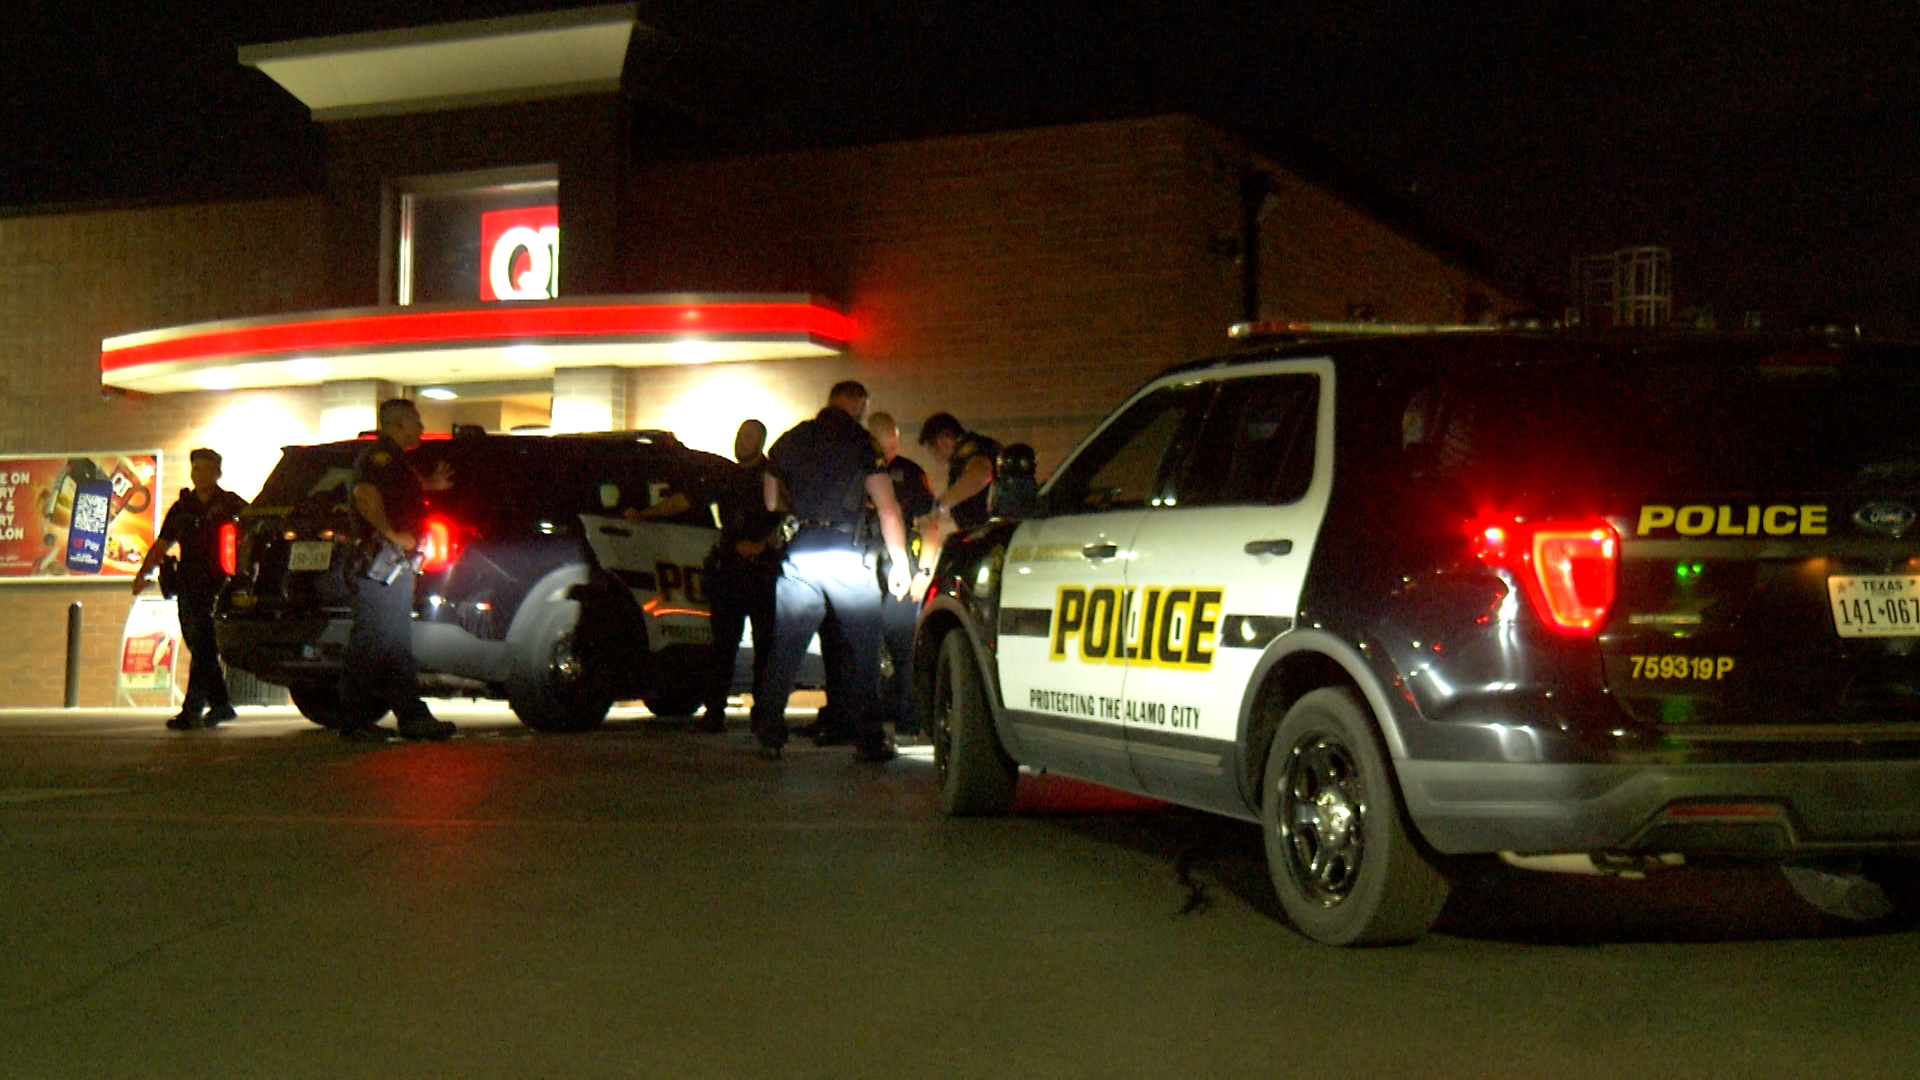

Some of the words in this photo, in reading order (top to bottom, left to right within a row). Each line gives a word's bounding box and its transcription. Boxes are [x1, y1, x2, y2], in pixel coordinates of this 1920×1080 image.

[11, 472, 30, 484] ON
[1637, 505, 1828, 536] POLICE
[1862, 581, 1903, 592] TEXAS
[1051, 586, 1223, 670] POLICE
[1630, 656, 1735, 680] 759319P
[1029, 689, 1095, 717] PROTECTING
[1099, 697, 1121, 720] THE
[1125, 701, 1166, 726] ALAMO
[1171, 705, 1201, 730] CITY
